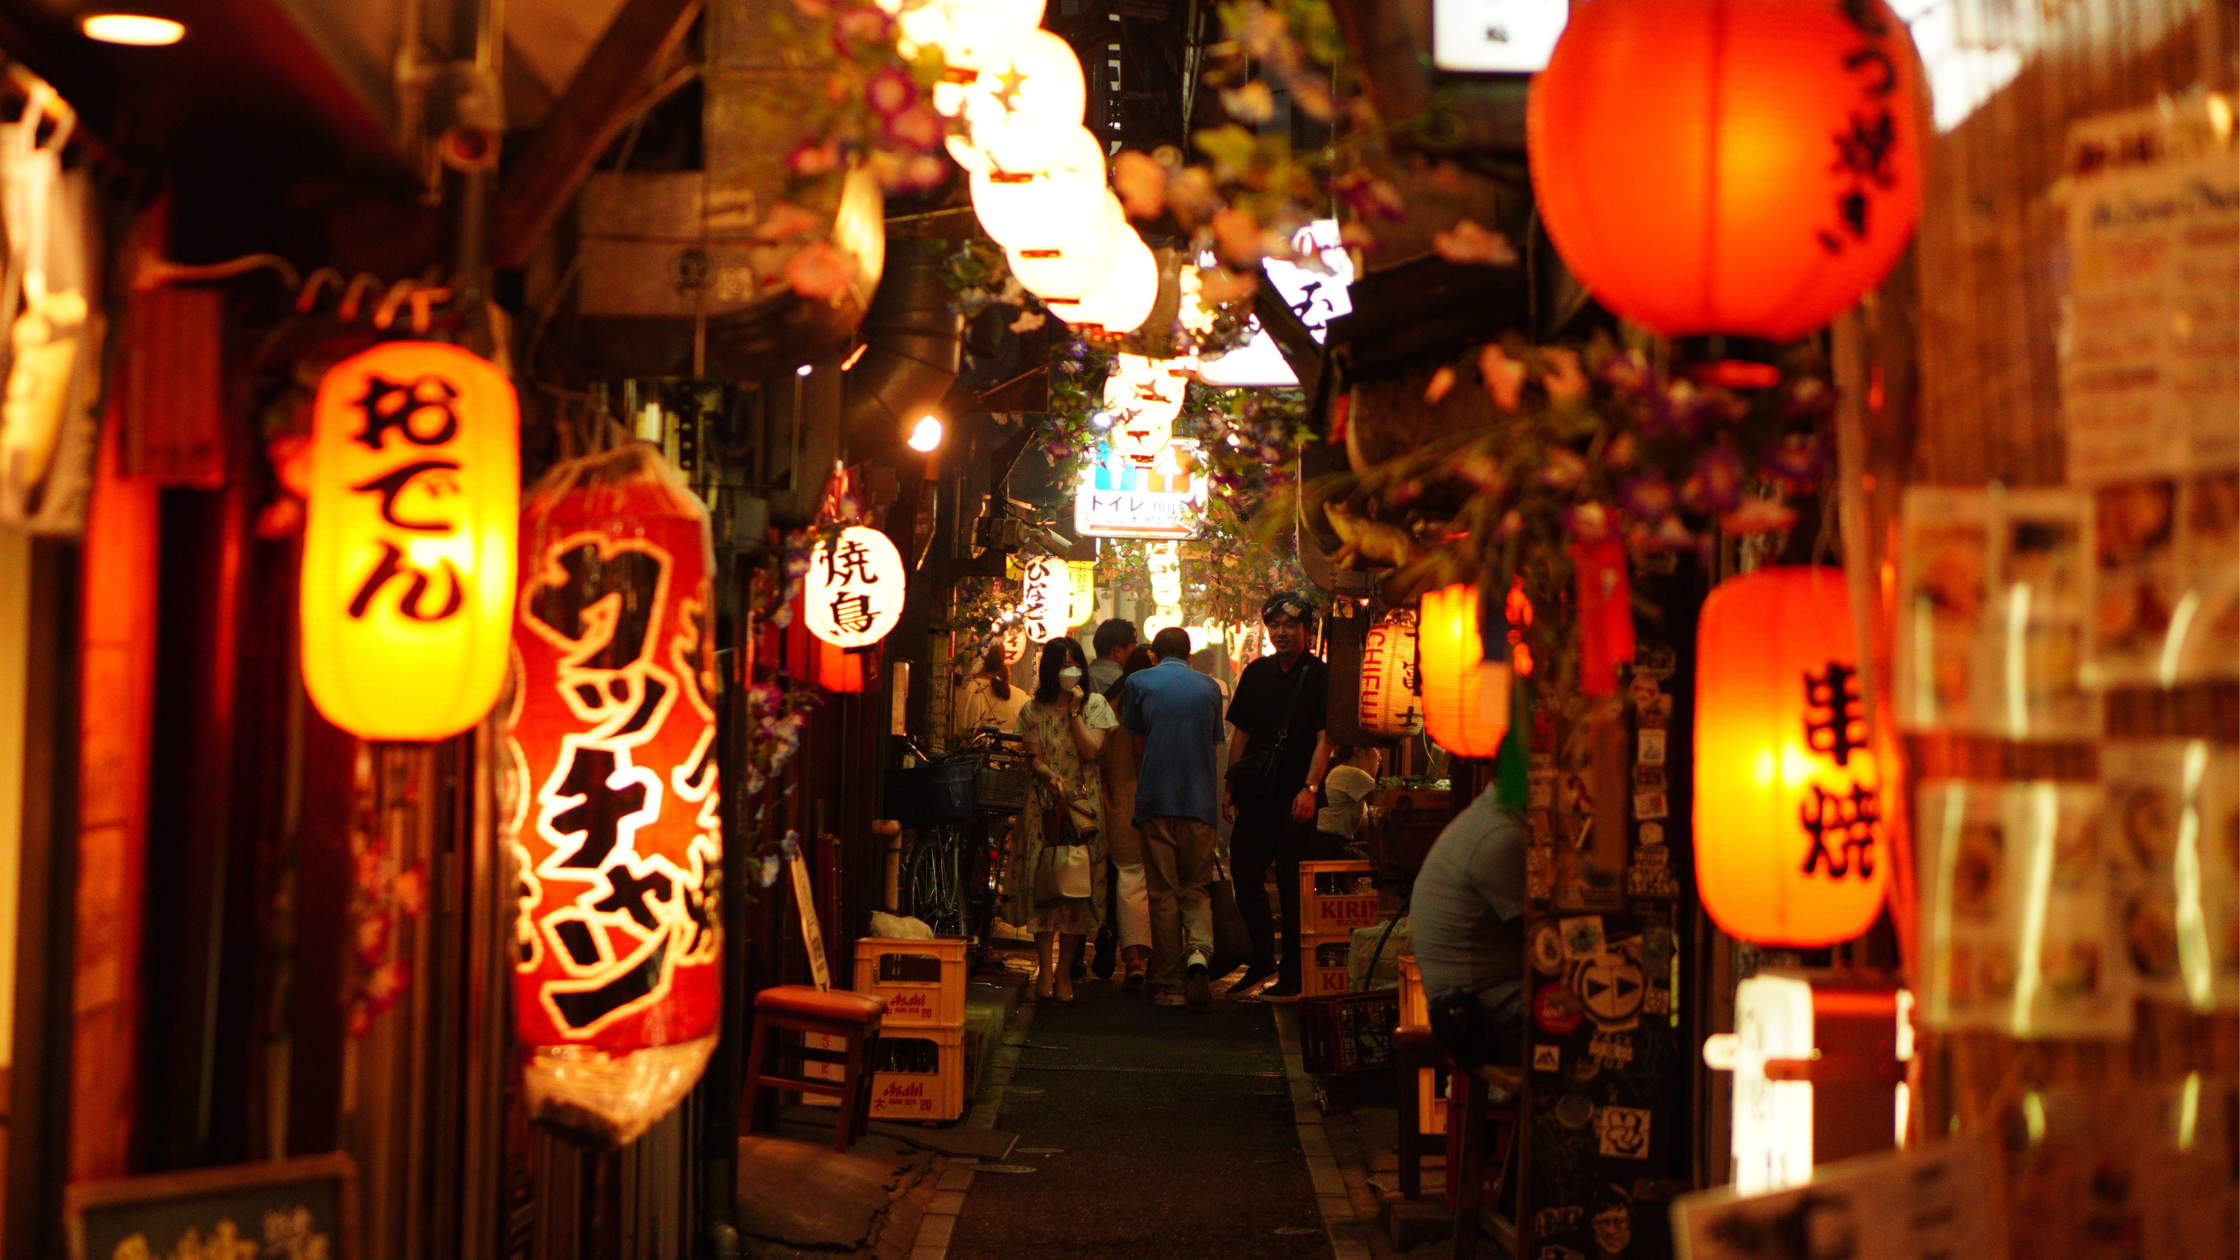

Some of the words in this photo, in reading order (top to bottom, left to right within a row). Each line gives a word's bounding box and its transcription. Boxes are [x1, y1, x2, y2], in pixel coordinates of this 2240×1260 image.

[350, 376, 462, 620] おでん
[1092, 495, 1144, 511] トイレ
[819, 541, 881, 636] 焼鳥
[1802, 664, 1877, 877] 串焼
[1321, 900, 1378, 918] KIRIN
[890, 992, 926, 1006] Asahi
[921, 1008, 932, 1018] 20
[883, 1081, 923, 1097] Asahi
[874, 1098, 885, 1109] 大
[920, 1099, 932, 1110] 20
